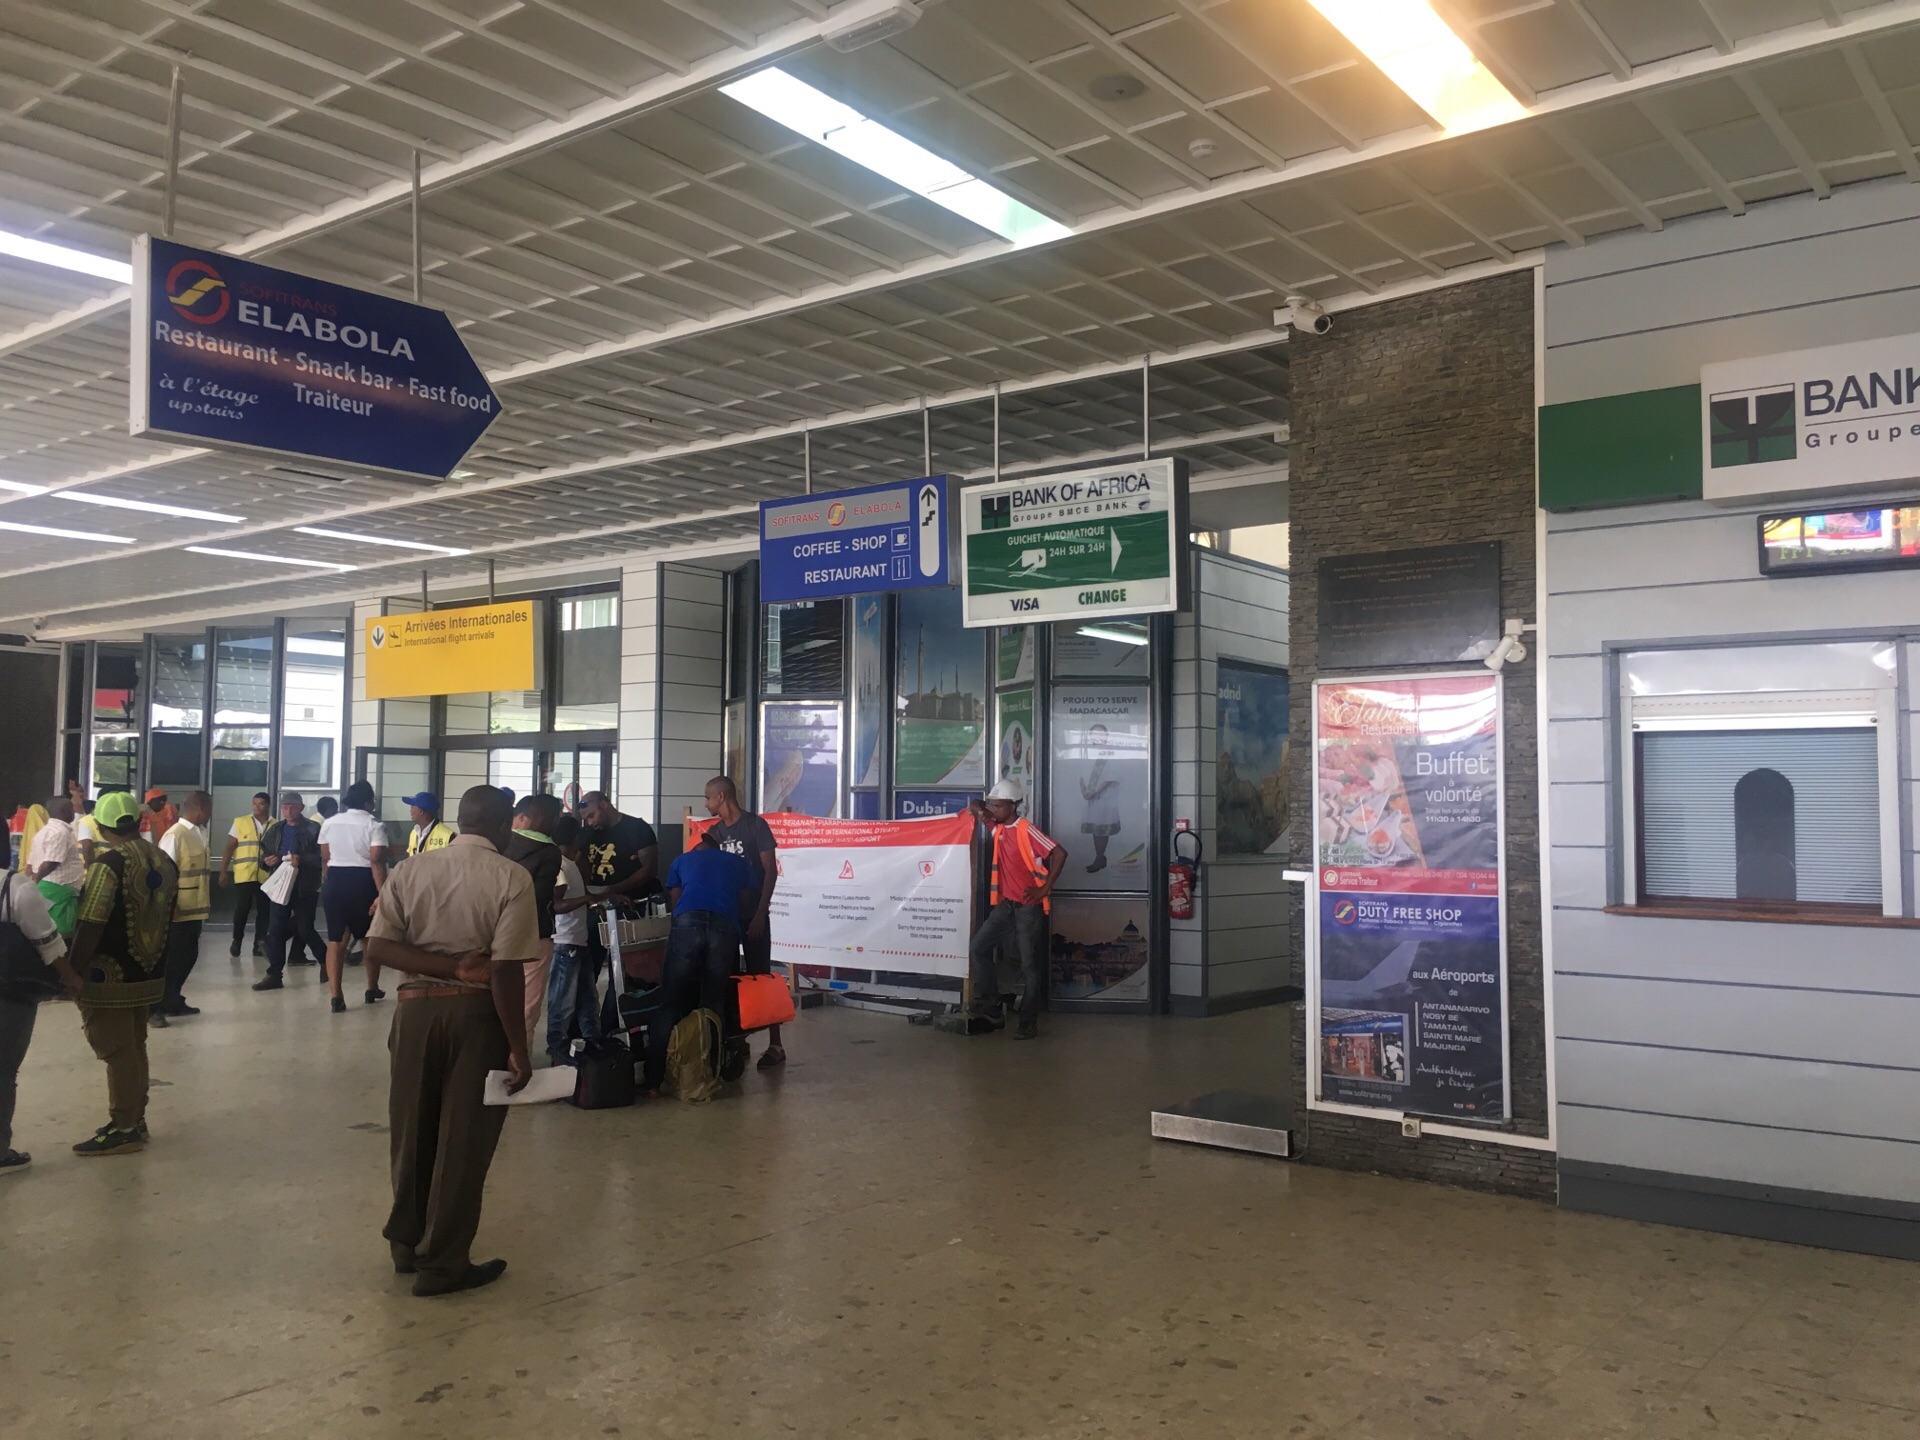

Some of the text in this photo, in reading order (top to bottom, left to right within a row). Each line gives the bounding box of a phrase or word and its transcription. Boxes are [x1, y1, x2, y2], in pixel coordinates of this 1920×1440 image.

[238, 299, 416, 362] ELABOLA
[155, 320, 278, 366] Restaurant
[296, 352, 356, 383] Snack
[360, 366, 394, 391] bar
[408, 377, 447, 403] Fast
[450, 386, 492, 413] food
[159, 373, 175, 390] à
[293, 383, 373, 417] Traiteur
[168, 399, 244, 420] upstairs
[1012, 472, 1151, 509] BANK OF AFRICA
[771, 500, 902, 528] SOFITRANS ELABOLA
[1012, 501, 1129, 524] Groupe BMCE BANK
[1007, 525, 1105, 546] GUICHET AUTOMATIQUE
[793, 539, 842, 560] COFFEE
[851, 534, 888, 553] SHOP
[1049, 542, 1106, 558] 24H SUR 24H
[804, 562, 888, 585] RESTAURANT
[1009, 588, 1127, 612] VISA CHANGE
[405, 610, 528, 634] Arrivées Internationales
[404, 629, 495, 647] International flight arrivals
[1063, 696, 1138, 704] PROUD TO SERVE
[1219, 683, 1242, 700] adrid
[1069, 707, 1129, 715] MADAGASCAR
[1416, 751, 1489, 776] Buffet
[1425, 786, 1482, 802] volonté
[903, 800, 947, 815] Dubai
[789, 828, 824, 836] AEROPORT
[787, 837, 833, 845] INTERNATIONAL
[1358, 906, 1462, 921] DUTY FREE SHOP
[1412, 967, 1495, 985] aux Aéroports
[1448, 988, 1458, 996] de
[1422, 1003, 1490, 1014] ANTANANARIVO
[1422, 1012, 1459, 1022] NOSY BE
[1423, 1022, 1468, 1032] TAMATAVE
[1423, 1032, 1482, 1043] SAINTE MARIE
[1423, 1041, 1467, 1051] MAJUNGA
